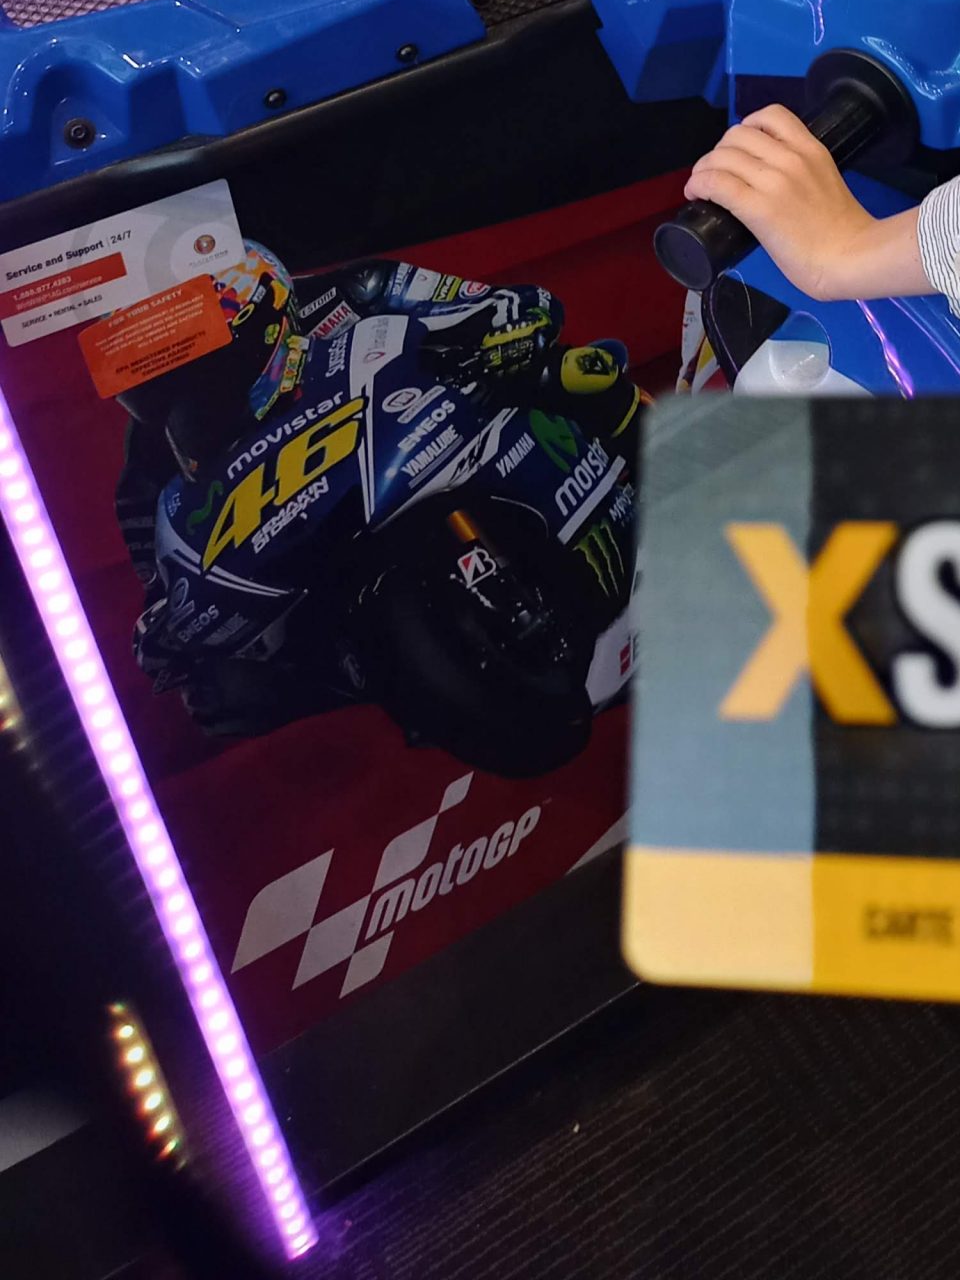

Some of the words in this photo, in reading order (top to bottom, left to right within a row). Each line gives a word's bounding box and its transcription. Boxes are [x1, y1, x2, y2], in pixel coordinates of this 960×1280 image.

[6, 262, 43, 280] Service
[45, 254, 63, 267] and
[65, 241, 104, 261] Support
[110, 230, 131, 245] 24/7
[150, 289, 182, 308] SAFETY
[311, 304, 352, 340] AMAHA
[227, 391, 344, 480] movistar
[398, 399, 456, 452] ENEOS
[401, 424, 460, 477] YAMALUBE
[495, 432, 536, 478] YAMAHA
[203, 398, 365, 571] 46
[863, 903, 956, 947] CARTE
